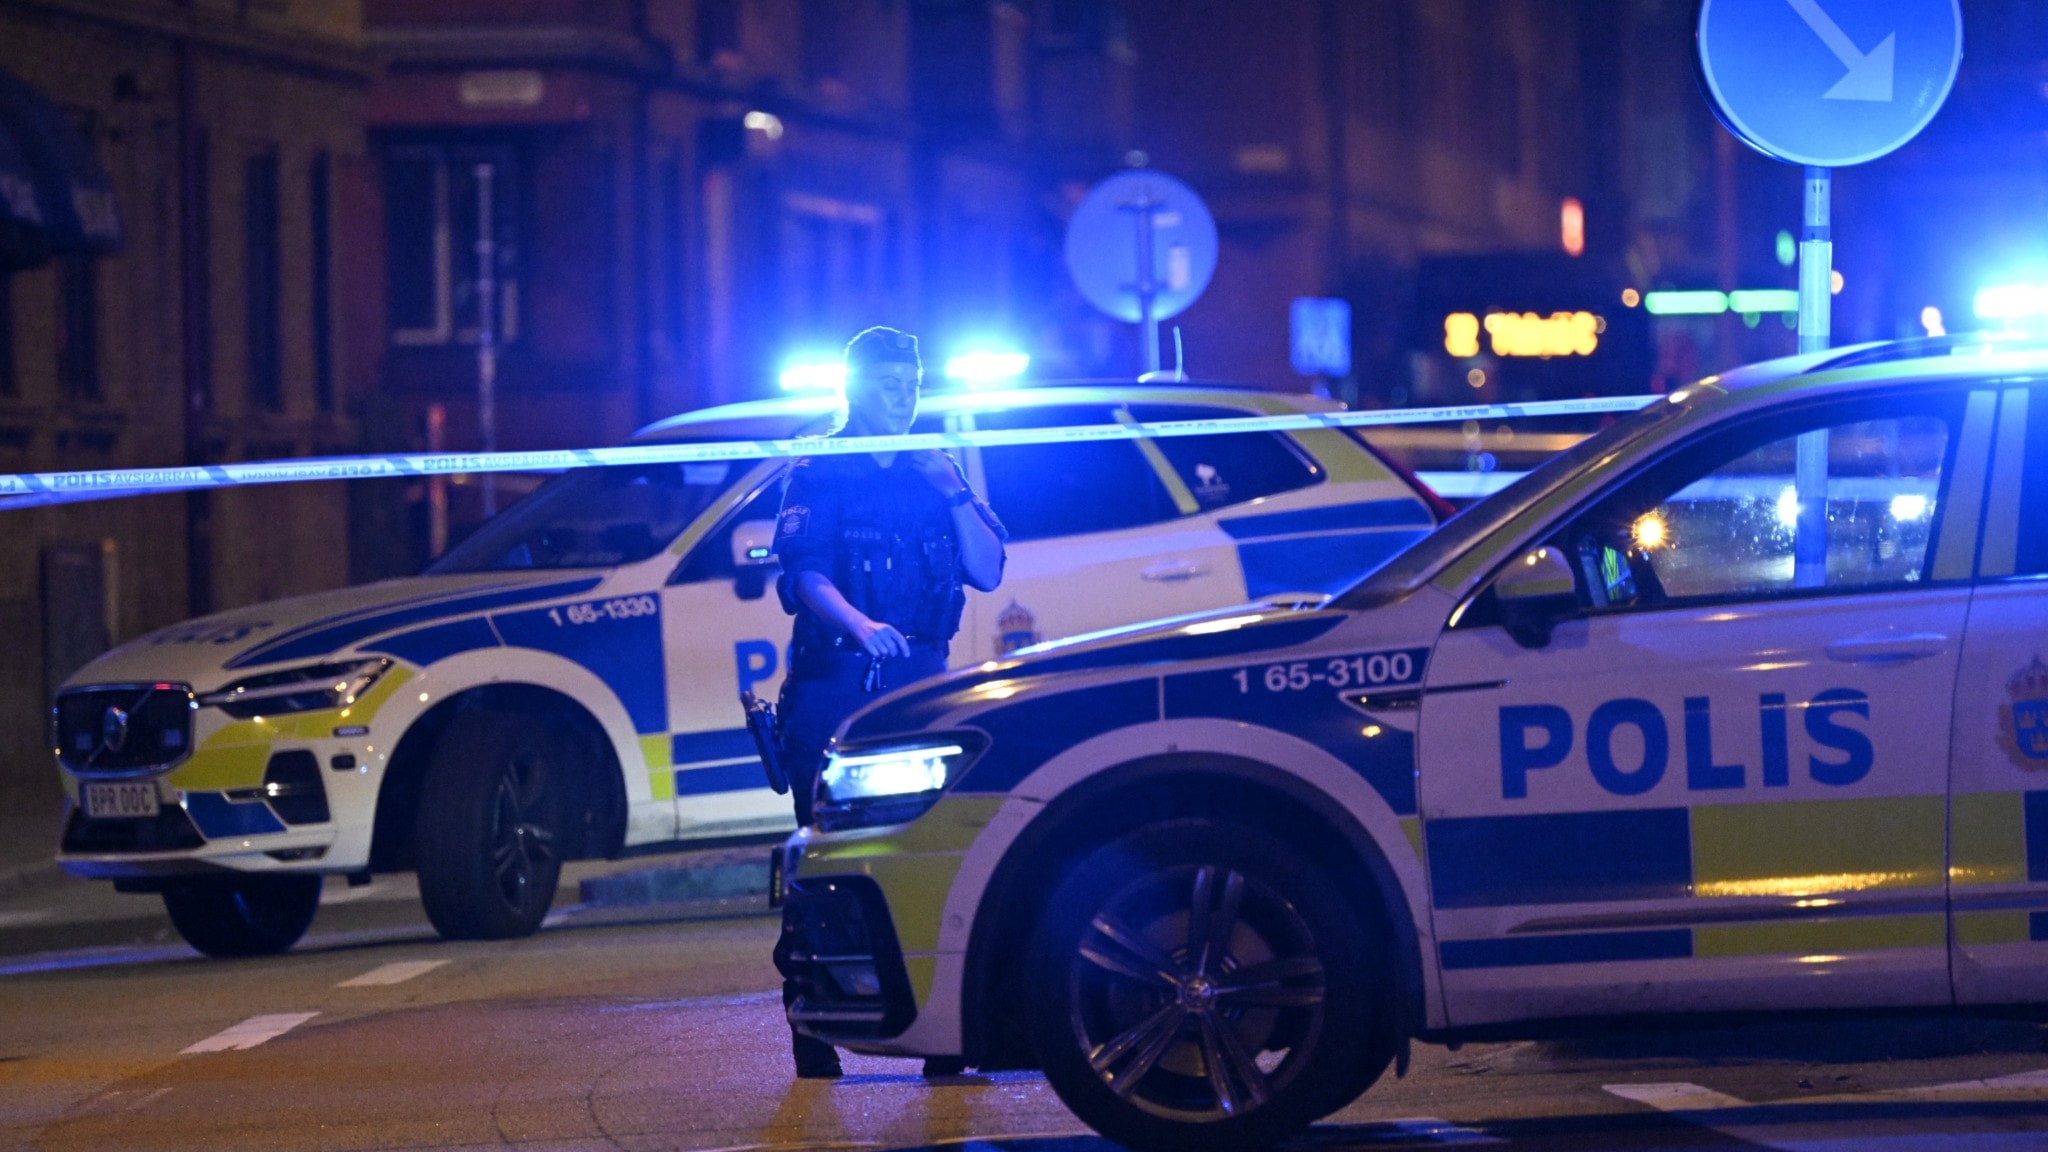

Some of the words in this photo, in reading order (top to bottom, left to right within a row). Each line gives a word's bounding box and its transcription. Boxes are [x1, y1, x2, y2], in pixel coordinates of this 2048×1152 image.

[423, 457, 481, 471] POLIS
[53, 473, 112, 488] POLIS
[548, 607, 563, 627] 1
[567, 595, 658, 625] 65-1330
[1233, 669, 1248, 693] 1
[1264, 653, 1413, 692] 65-3100
[1499, 687, 1875, 801] POLIS
